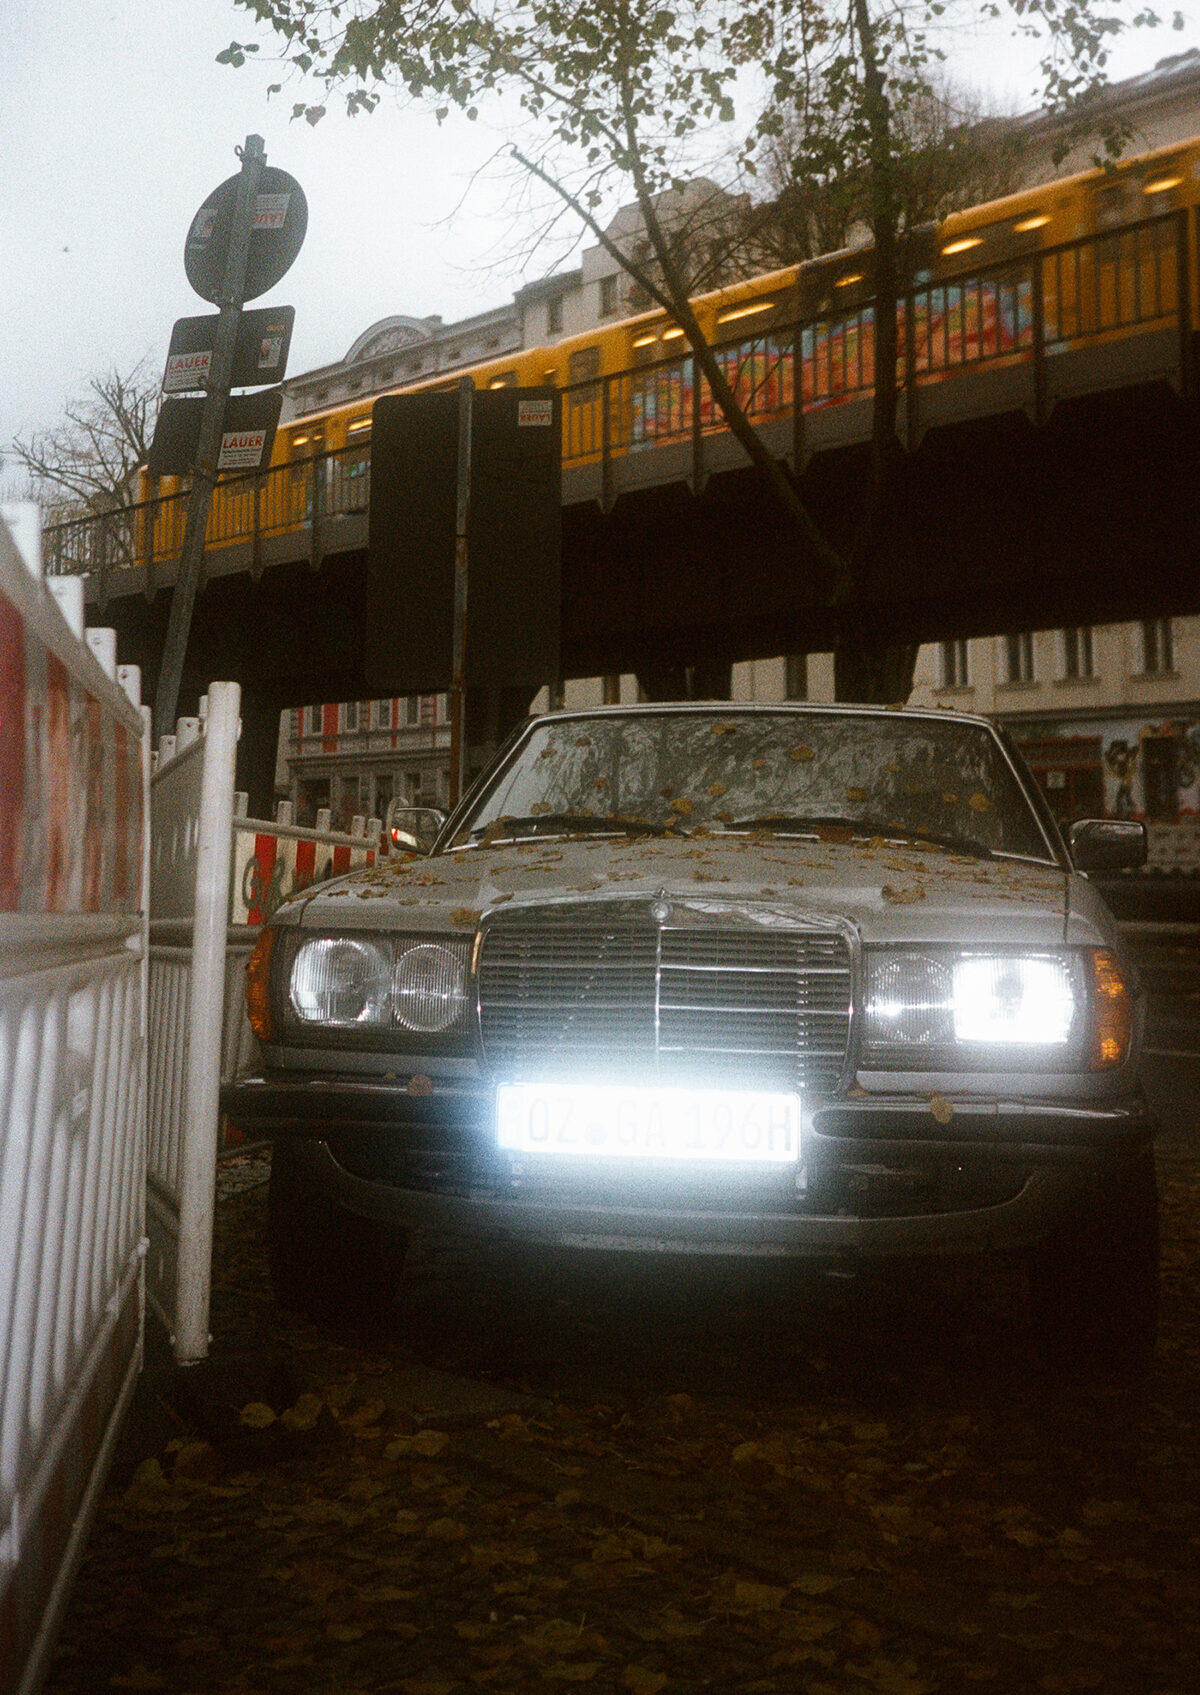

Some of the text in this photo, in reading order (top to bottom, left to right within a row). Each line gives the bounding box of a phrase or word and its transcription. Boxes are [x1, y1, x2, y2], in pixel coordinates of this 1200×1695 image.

[169, 354, 210, 371] LAUER
[222, 433, 263, 449] LAUER
[615, 1099, 666, 1148] GA
[685, 1102, 793, 1152] 196H
